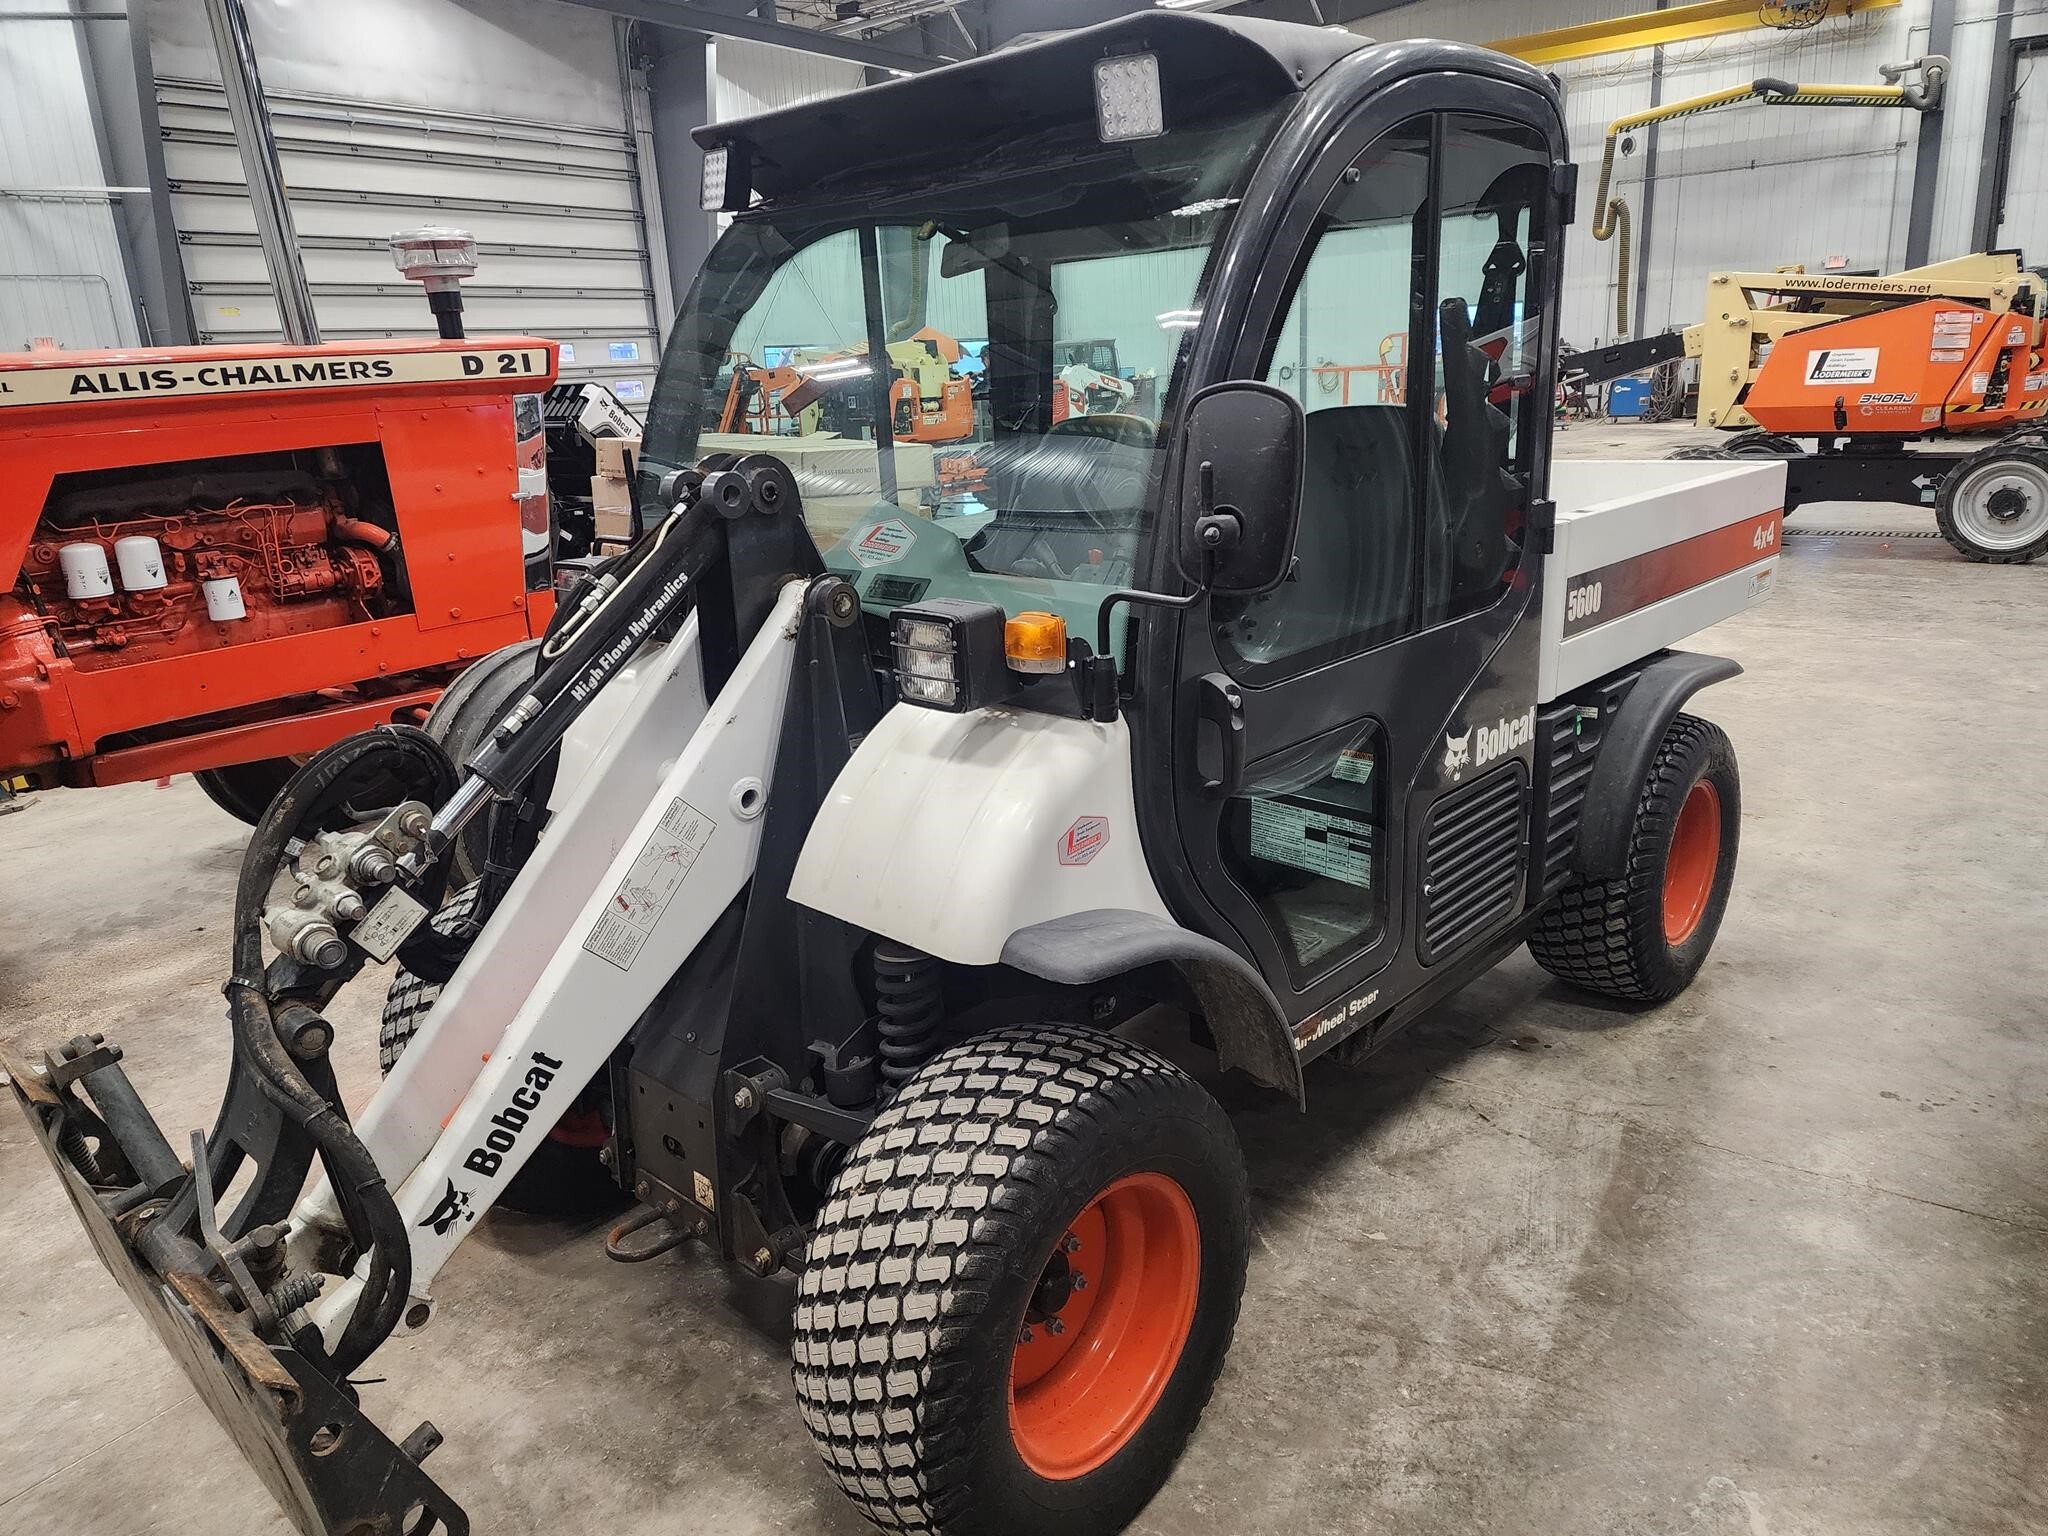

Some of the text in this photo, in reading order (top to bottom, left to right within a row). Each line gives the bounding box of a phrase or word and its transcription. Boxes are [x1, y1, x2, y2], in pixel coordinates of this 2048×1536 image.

[1785, 277, 1931, 294] www.lodermeiers.net
[70, 359, 394, 395] ALLIS-CHALMERS
[461, 353, 532, 376] D 21
[1813, 369, 1871, 379] LODERMEIER'S
[1857, 392, 1919, 405] 340AJ
[608, 409, 632, 436] Bobcat
[1752, 520, 1775, 550] 4x4
[1567, 581, 1603, 622] 5600
[570, 572, 689, 702] High Flow Hydraulics
[1475, 705, 1536, 767] Bobcat
[1349, 989, 1379, 1017] Steer
[463, 1051, 563, 1178] Bobcat
